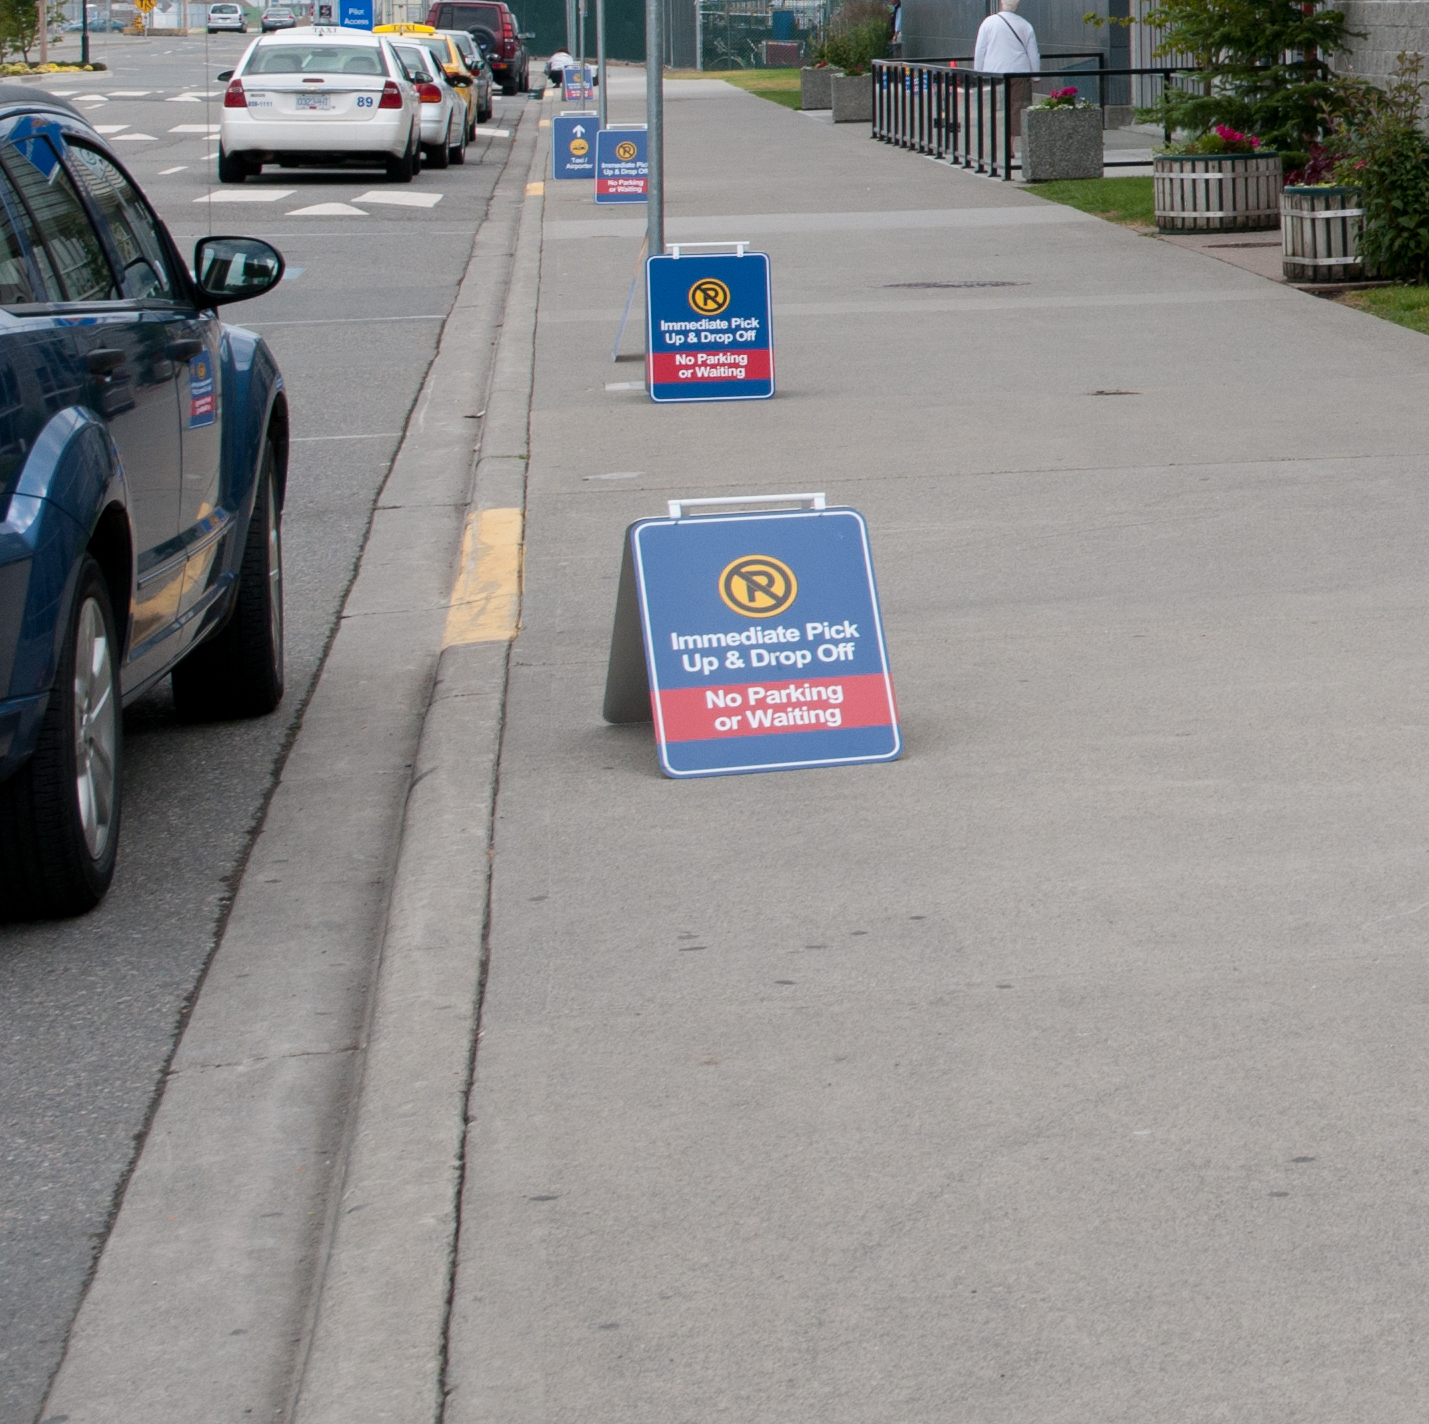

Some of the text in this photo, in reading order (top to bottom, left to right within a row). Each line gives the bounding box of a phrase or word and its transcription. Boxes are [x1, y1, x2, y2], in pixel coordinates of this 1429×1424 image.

[344, 17, 369, 25] Access
[357, 96, 373, 107] 89
[620, 168, 638, 176] Drop
[617, 185, 642, 193] Waiting
[618, 179, 644, 187] Parking
[660, 317, 760, 331] Immediate Pick
[665, 330, 757, 346] Up & Drop Off
[675, 352, 748, 366] No Parking
[678, 366, 746, 379] or Waiting
[671, 620, 860, 650] Immediate Pick
[682, 642, 855, 675] Up & Drop Off
[706, 683, 844, 708] No Parking
[714, 706, 842, 731] or Waiting
